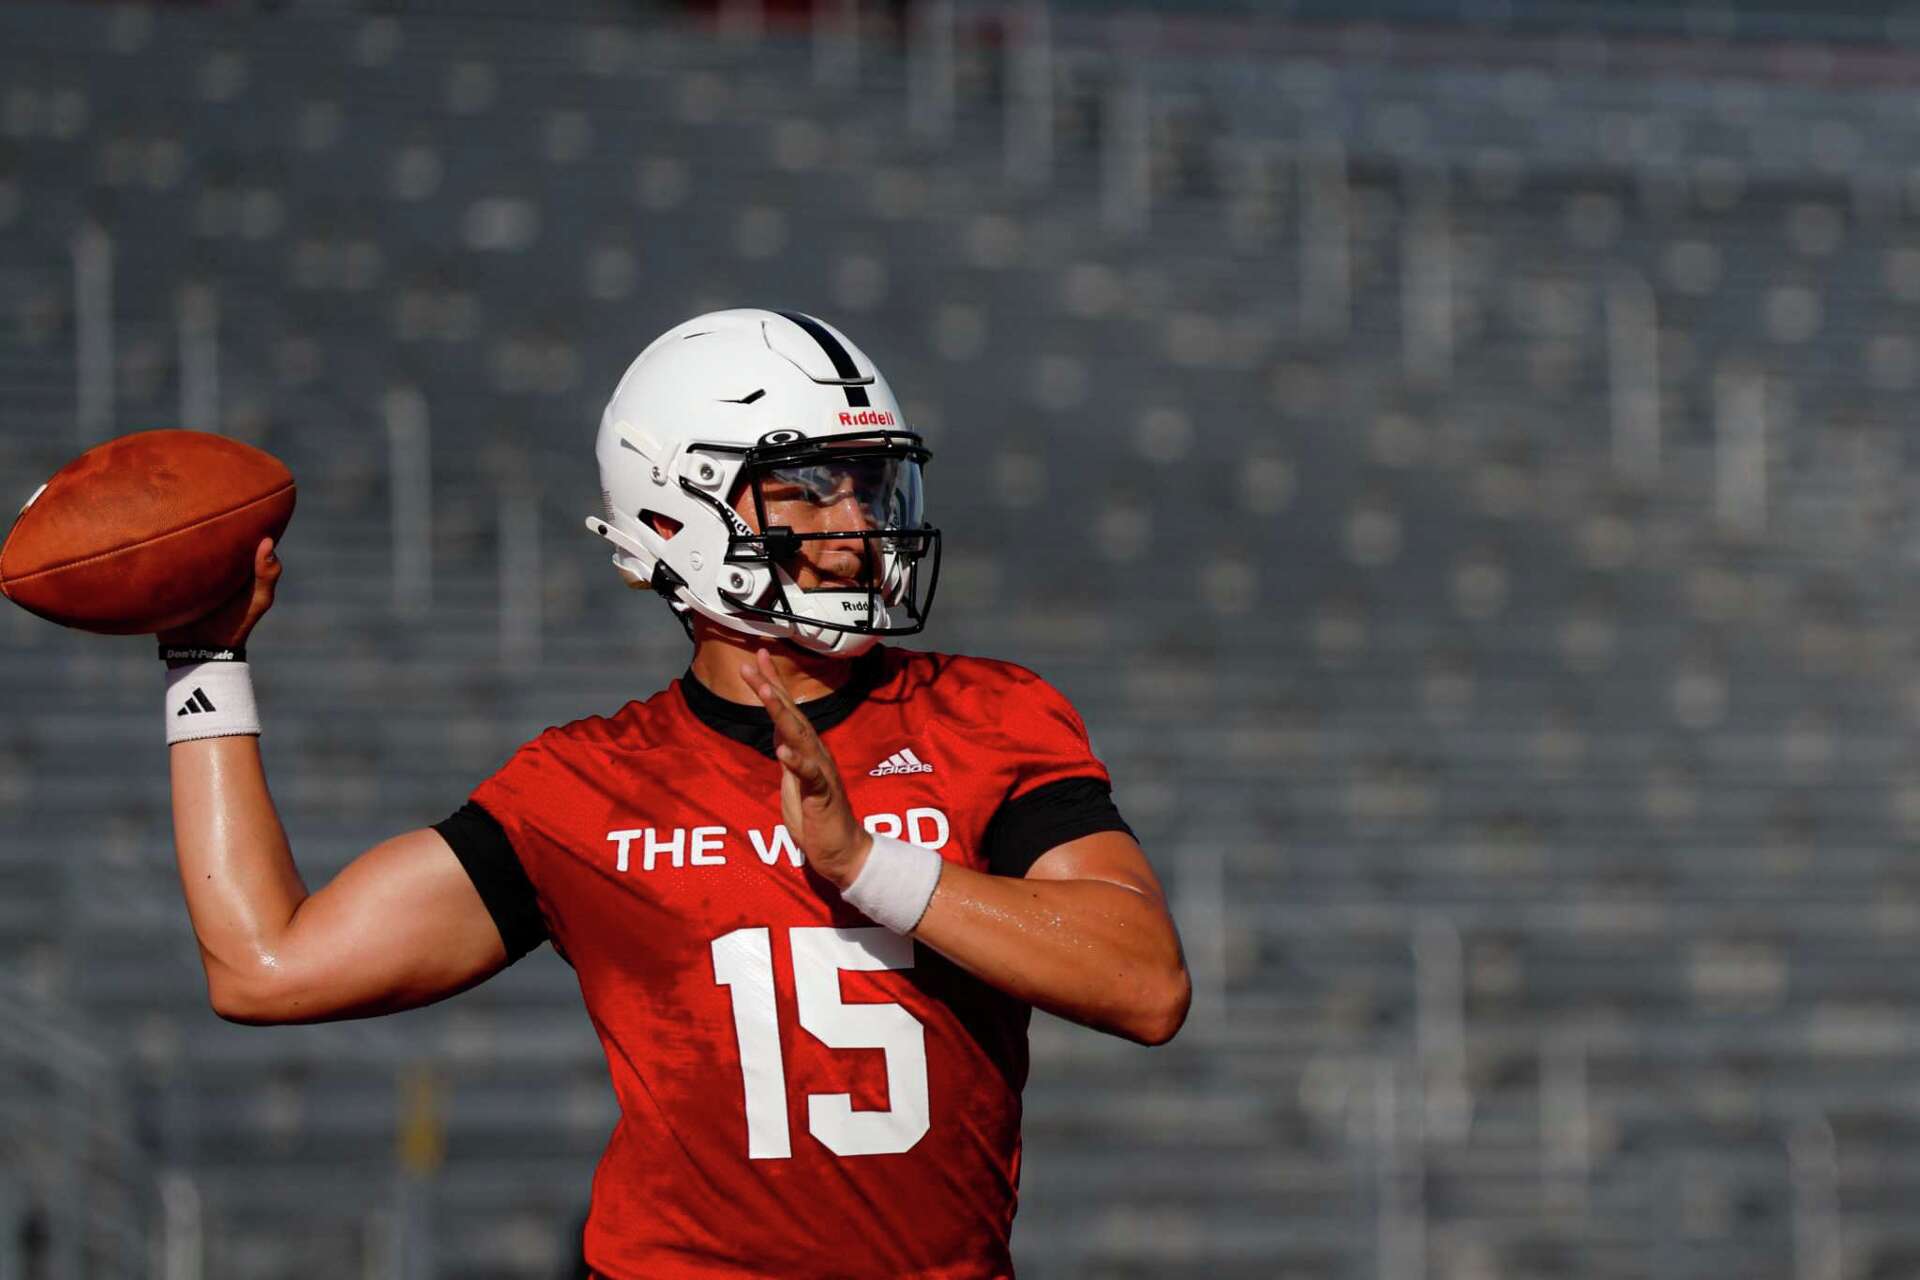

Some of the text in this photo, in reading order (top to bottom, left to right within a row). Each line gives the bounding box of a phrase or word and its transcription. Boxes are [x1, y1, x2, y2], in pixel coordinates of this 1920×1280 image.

[838, 410, 895, 426] Riddell
[841, 600, 871, 612] Ridd
[868, 763, 934, 777] adidas
[606, 807, 950, 872] THE WRD
[711, 926, 931, 1160] 15
